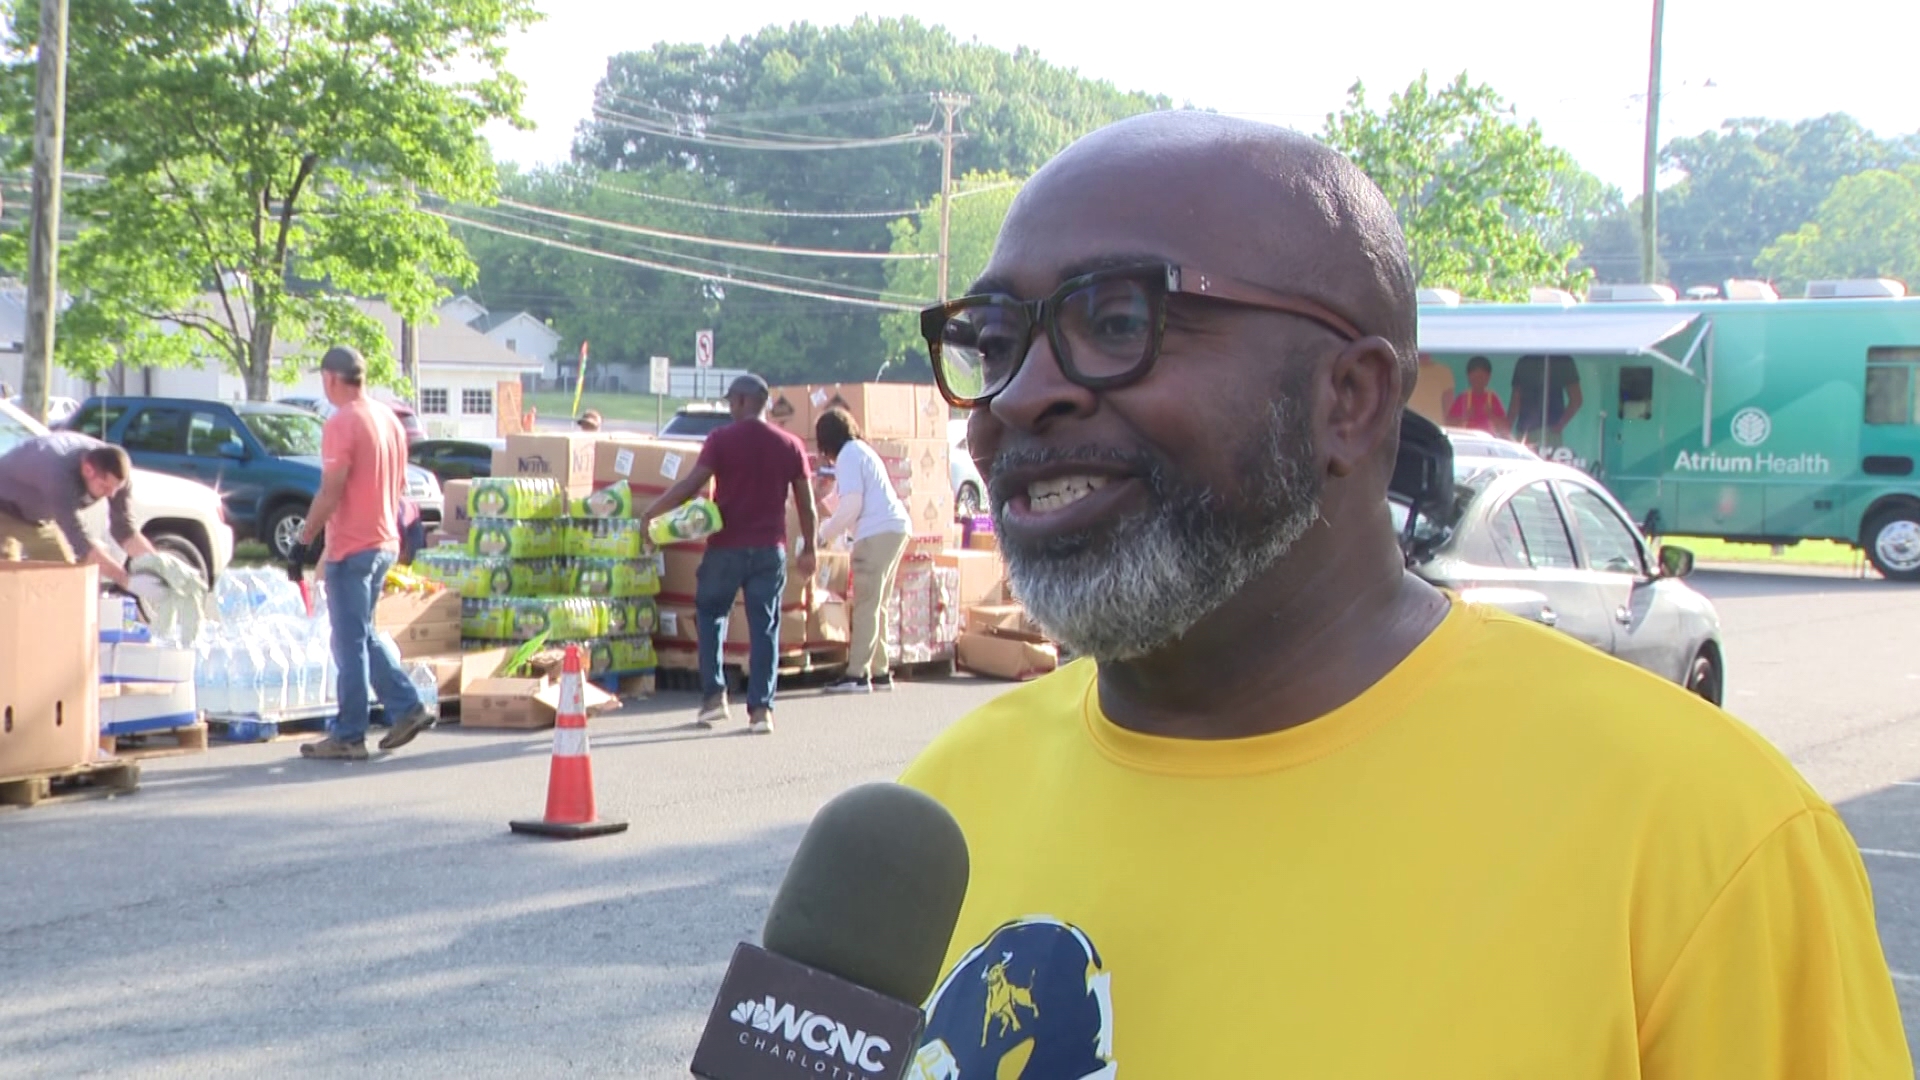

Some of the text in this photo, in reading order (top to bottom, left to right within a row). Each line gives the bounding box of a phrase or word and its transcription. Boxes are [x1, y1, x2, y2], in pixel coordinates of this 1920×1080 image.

[1674, 451, 1829, 473] Atrium Health
[763, 995, 891, 1072] WCNC
